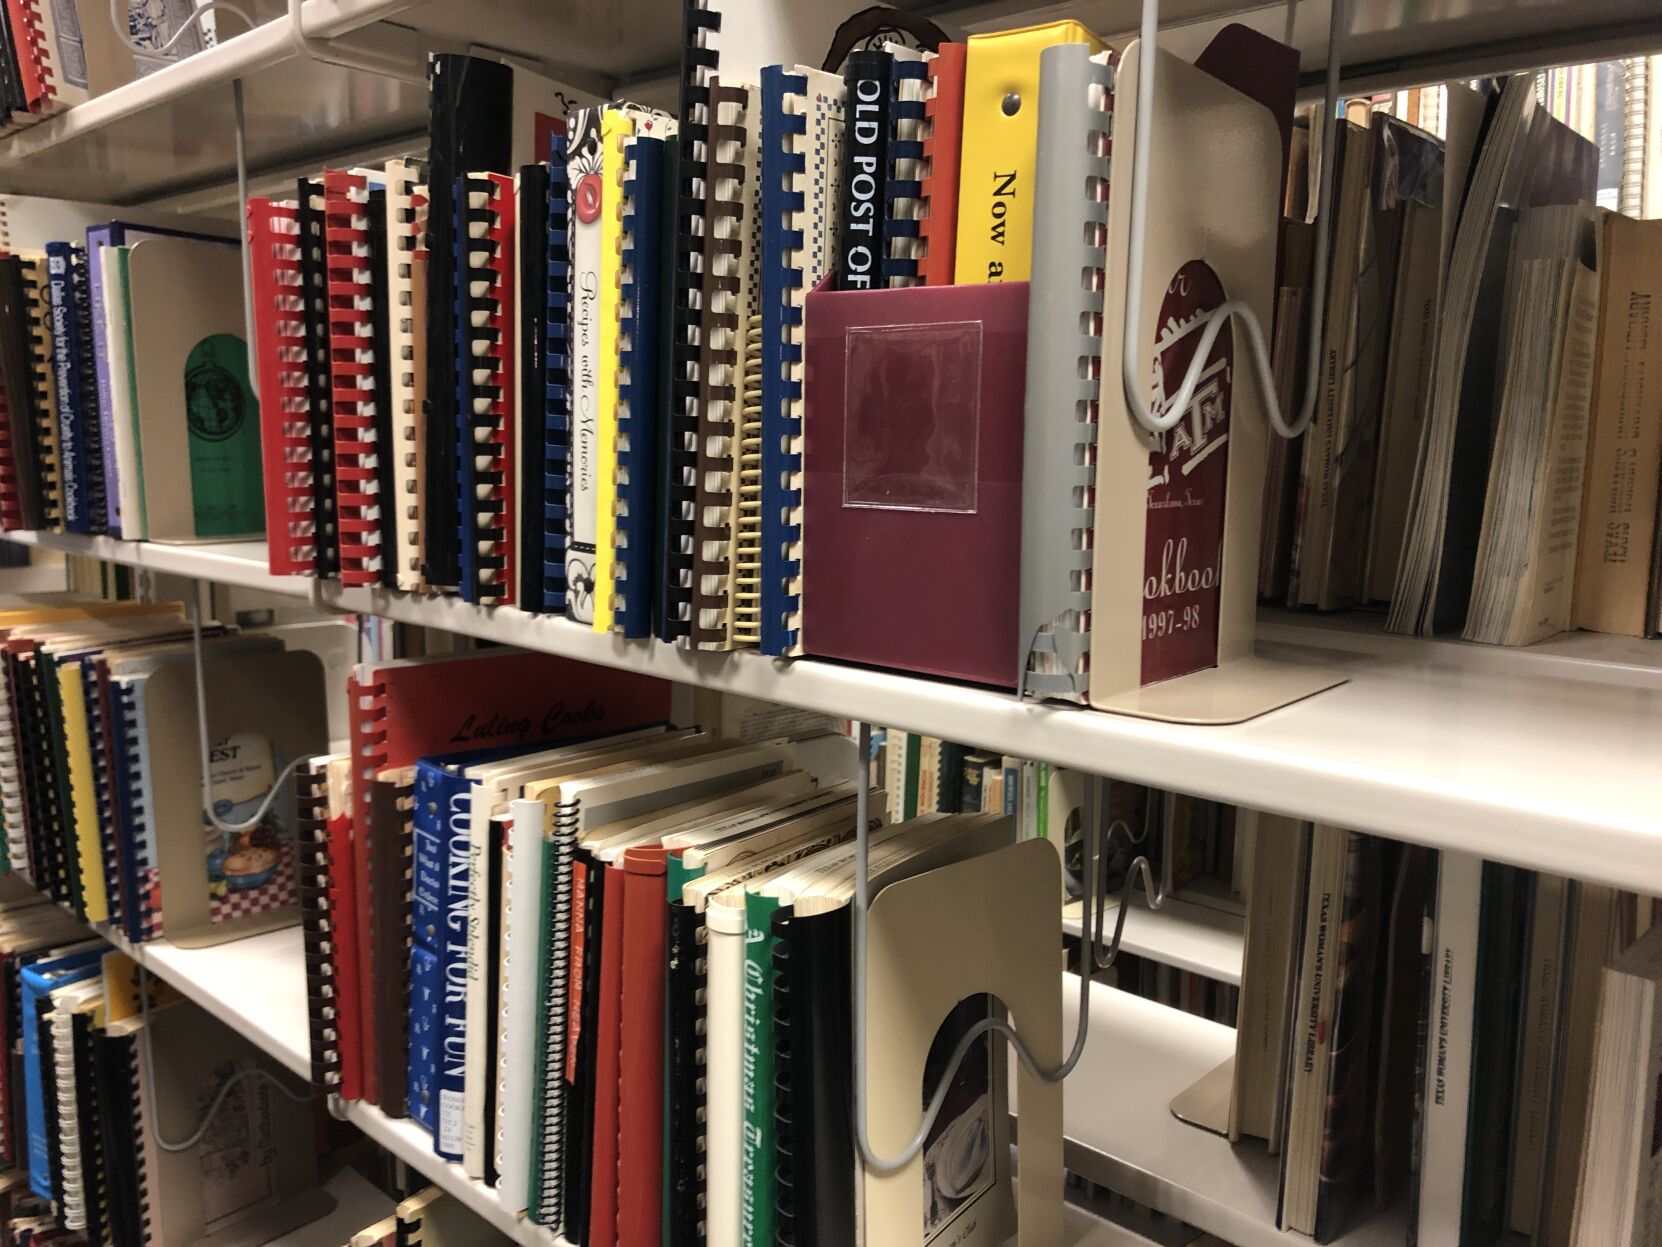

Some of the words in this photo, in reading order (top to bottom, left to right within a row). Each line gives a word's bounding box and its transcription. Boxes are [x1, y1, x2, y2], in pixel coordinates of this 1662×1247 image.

[854, 79, 881, 145] OLD
[850, 156, 877, 237] POST
[990, 169, 1018, 246] Now
[847, 245, 873, 289] OF
[987, 261, 1005, 284] a
[577, 271, 598, 347] Recipes
[581, 354, 595, 392] with
[579, 394, 595, 492] Memories
[1141, 604, 1200, 640] 1997-98
[450, 713, 531, 744] Luling
[541, 699, 606, 734] Cooks
[446, 792, 472, 931] COOKING
[467, 843, 482, 911] Perfectly
[575, 878, 586, 934] MANNA
[1319, 893, 1331, 923] TEXAS
[444, 940, 468, 1004] FOR
[466, 914, 480, 982] Splendid
[573, 945, 584, 991] FROM
[1315, 924, 1328, 972] WOMAN'S
[1308, 973, 1322, 1029] UNIVERSITY
[443, 1014, 467, 1077] FUN
[744, 958, 764, 1113] Christmas
[1304, 1031, 1317, 1073] LIBRARY
